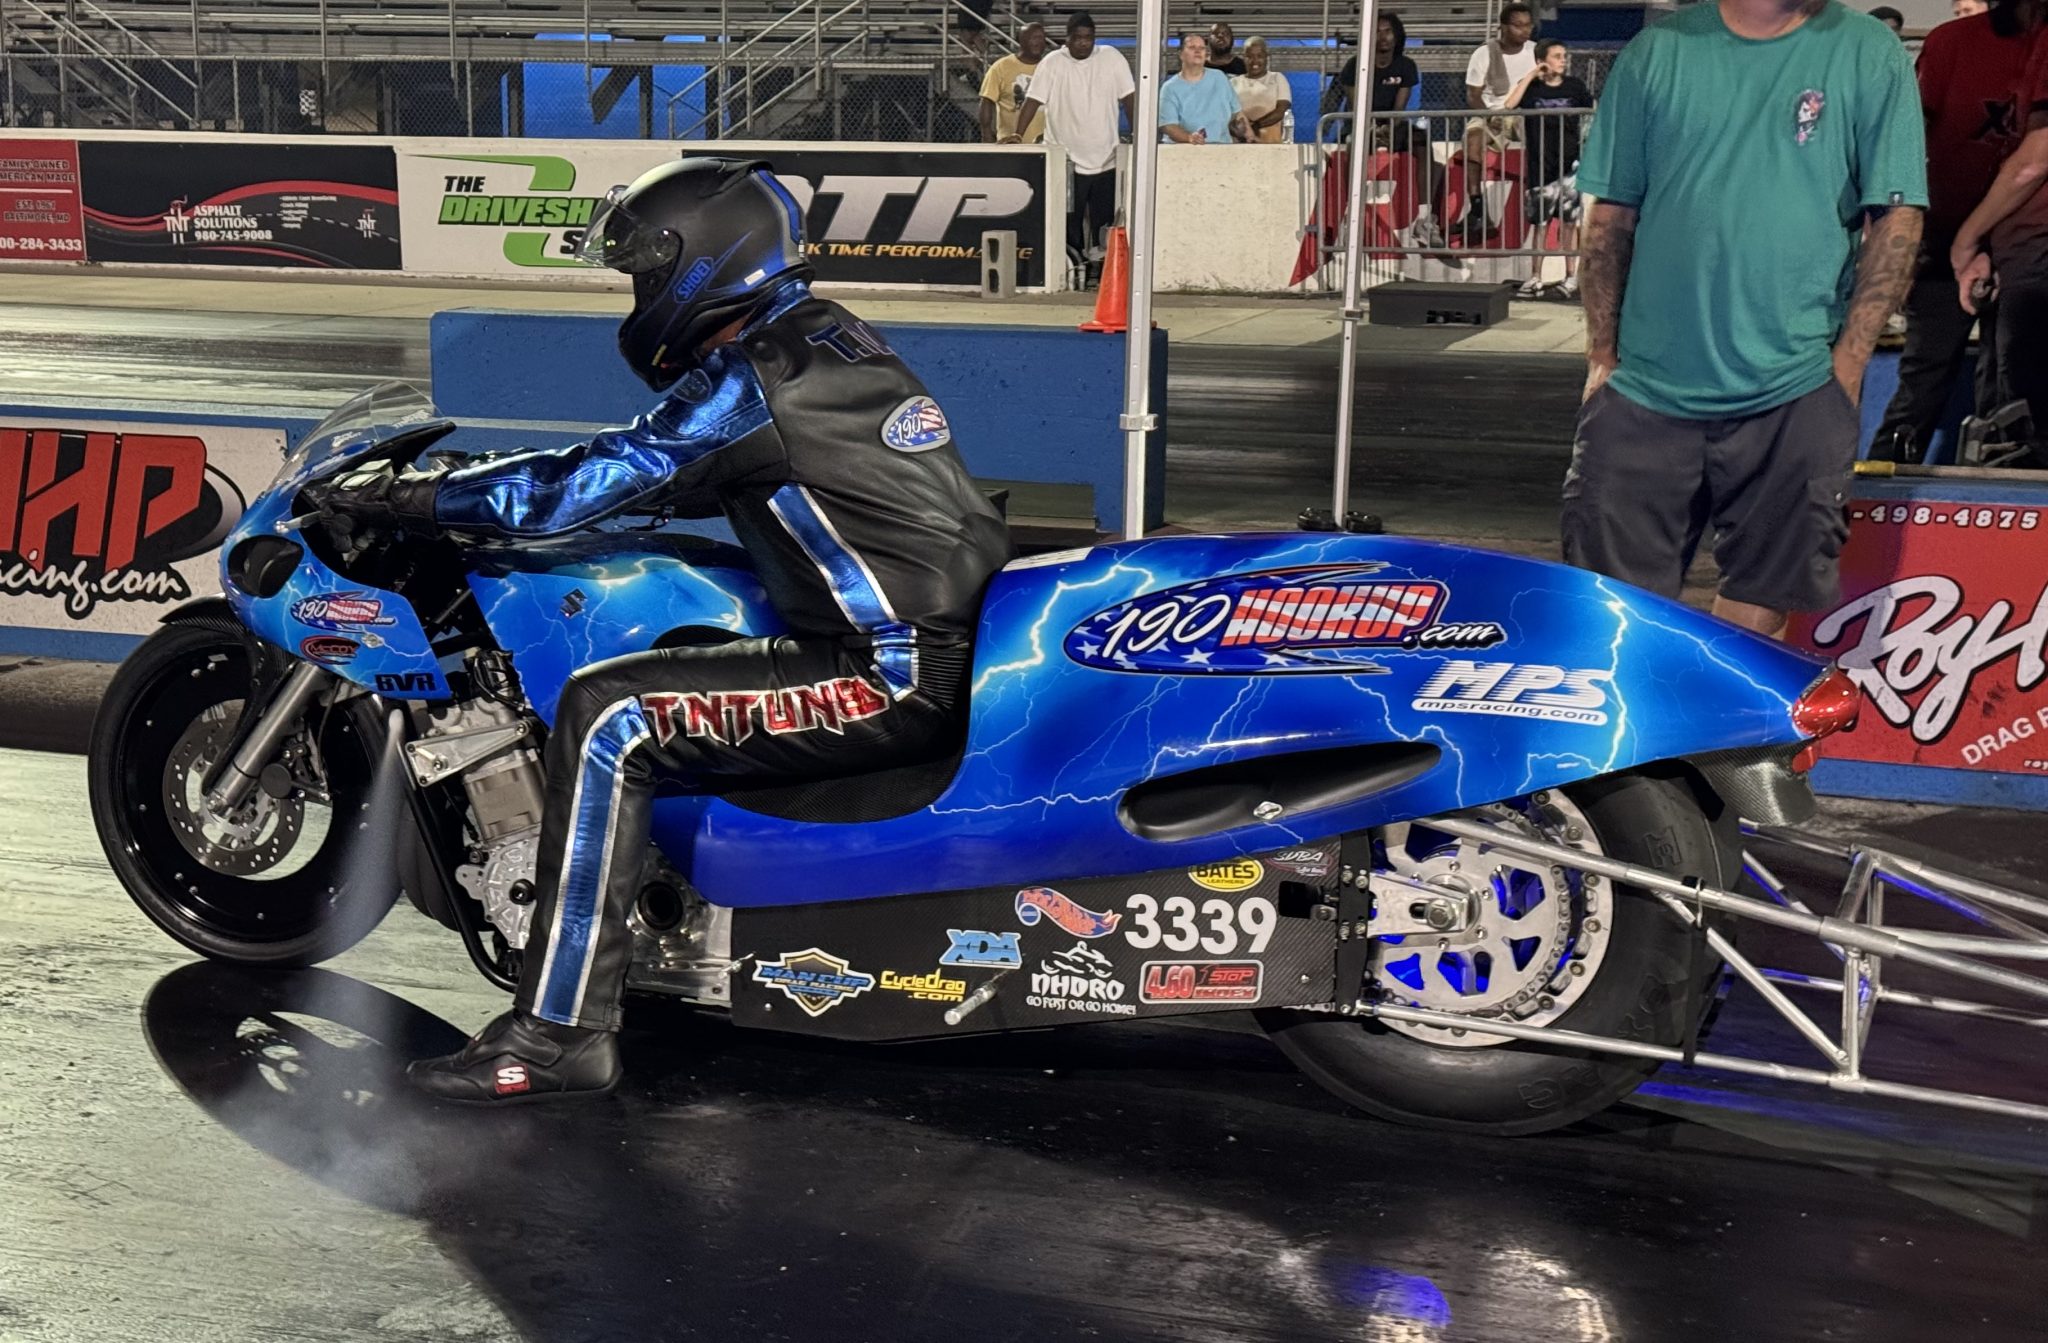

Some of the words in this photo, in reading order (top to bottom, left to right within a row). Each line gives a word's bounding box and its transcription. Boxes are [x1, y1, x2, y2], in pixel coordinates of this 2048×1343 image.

[445, 176, 486, 192] THE
[194, 205, 242, 216] ASPHALT
[438, 195, 604, 227] DRIVESH
[163, 212, 191, 238] TNT
[194, 217, 258, 229] SOLUTIONS
[195, 230, 273, 240] 980-745-9008
[828, 243, 874, 255] TIME
[876, 243, 1034, 260] PERFORME
[677, 260, 711, 298] SHOEI
[299, 601, 329, 618] 190
[1101, 593, 1231, 658] 190
[1413, 660, 1612, 708] MPS
[1420, 700, 1600, 722] mpsracing.com
[1961, 717, 2036, 766] DRAG
[1197, 863, 1255, 879] BATES
[1124, 894, 1278, 955] 3339
[940, 930, 1019, 961] XDA
[760, 966, 817, 981] MAN
[817, 973, 871, 988] CUP
[880, 968, 966, 994] CycleDrag
[1145, 965, 1196, 998] 4.60
[908, 992, 963, 1002] .com
[1026, 996, 1042, 1007] GO
[1068, 999, 1086, 1012] OR
[1086, 1001, 1101, 1013] GO
[497, 1066, 526, 1085] S
